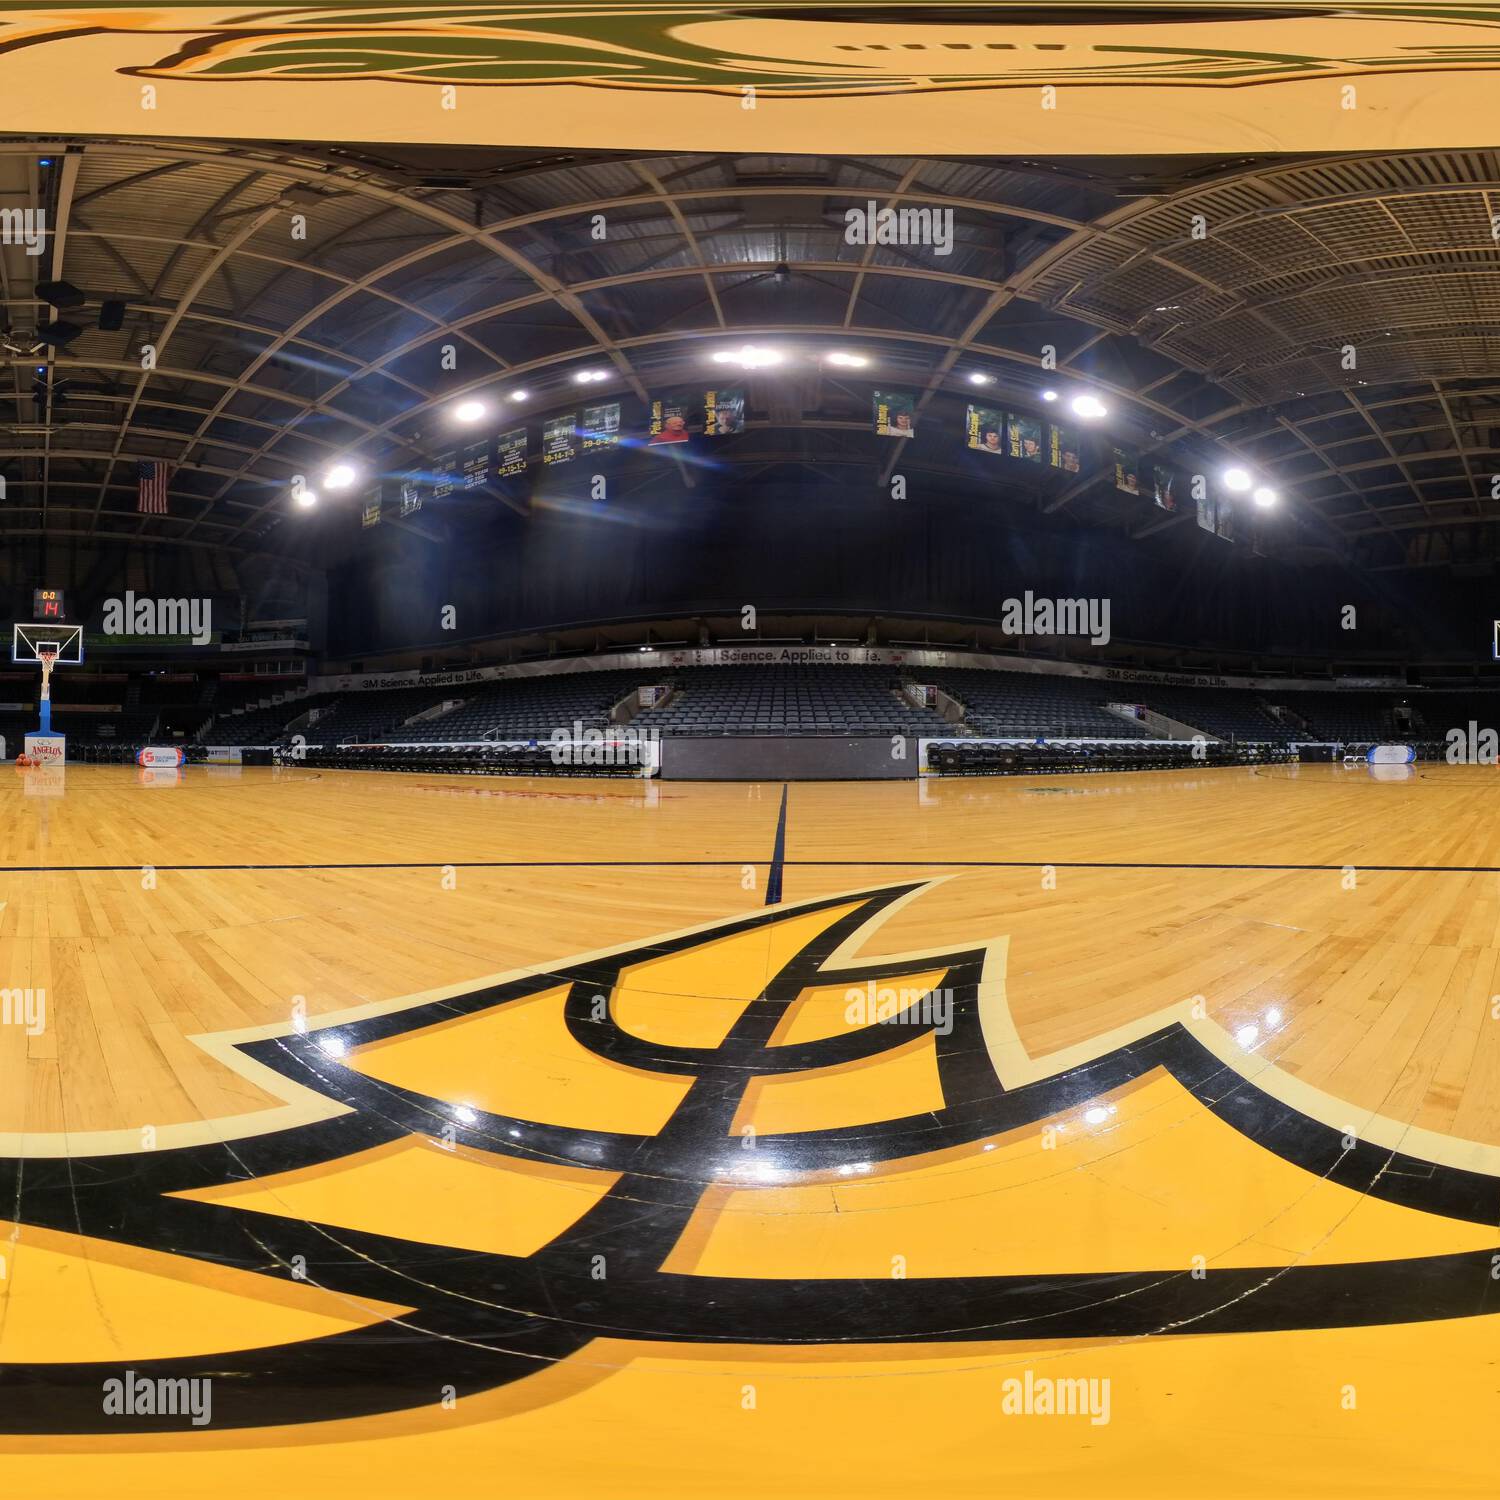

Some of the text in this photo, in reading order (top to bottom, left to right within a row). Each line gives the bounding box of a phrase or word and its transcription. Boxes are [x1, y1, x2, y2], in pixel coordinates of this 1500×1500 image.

[45, 602, 58, 616] 14
[721, 649, 849, 664] Science. Applied to
[362, 671, 484, 688] 3M Science. Applied to Life.
